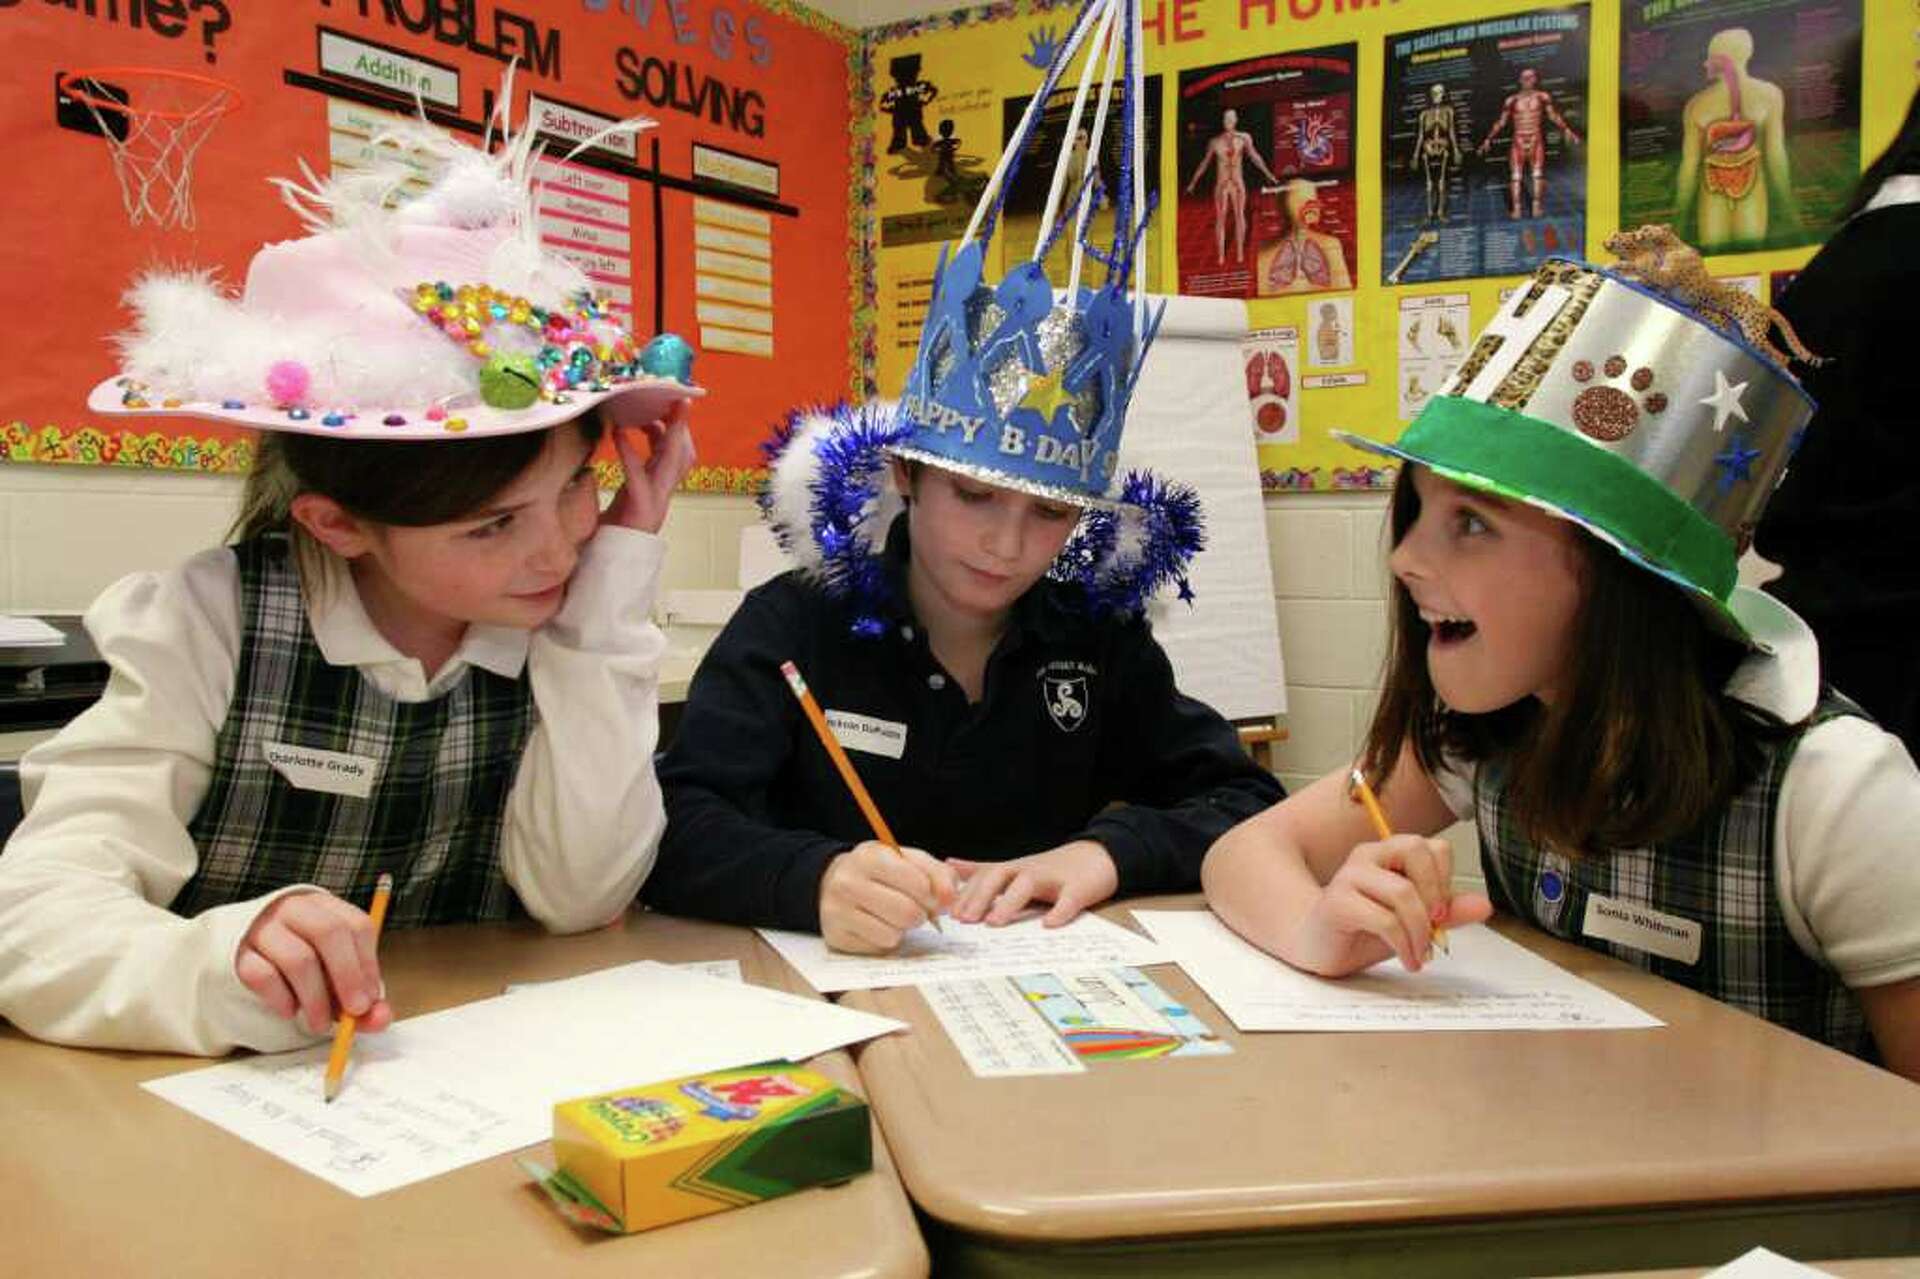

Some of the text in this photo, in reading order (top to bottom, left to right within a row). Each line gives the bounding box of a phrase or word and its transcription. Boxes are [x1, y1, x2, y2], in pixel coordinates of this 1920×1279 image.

[615, 47, 765, 138] SOLVING
[269, 751, 365, 777] Charlotte Grady
[1597, 904, 1629, 922] Sonia
